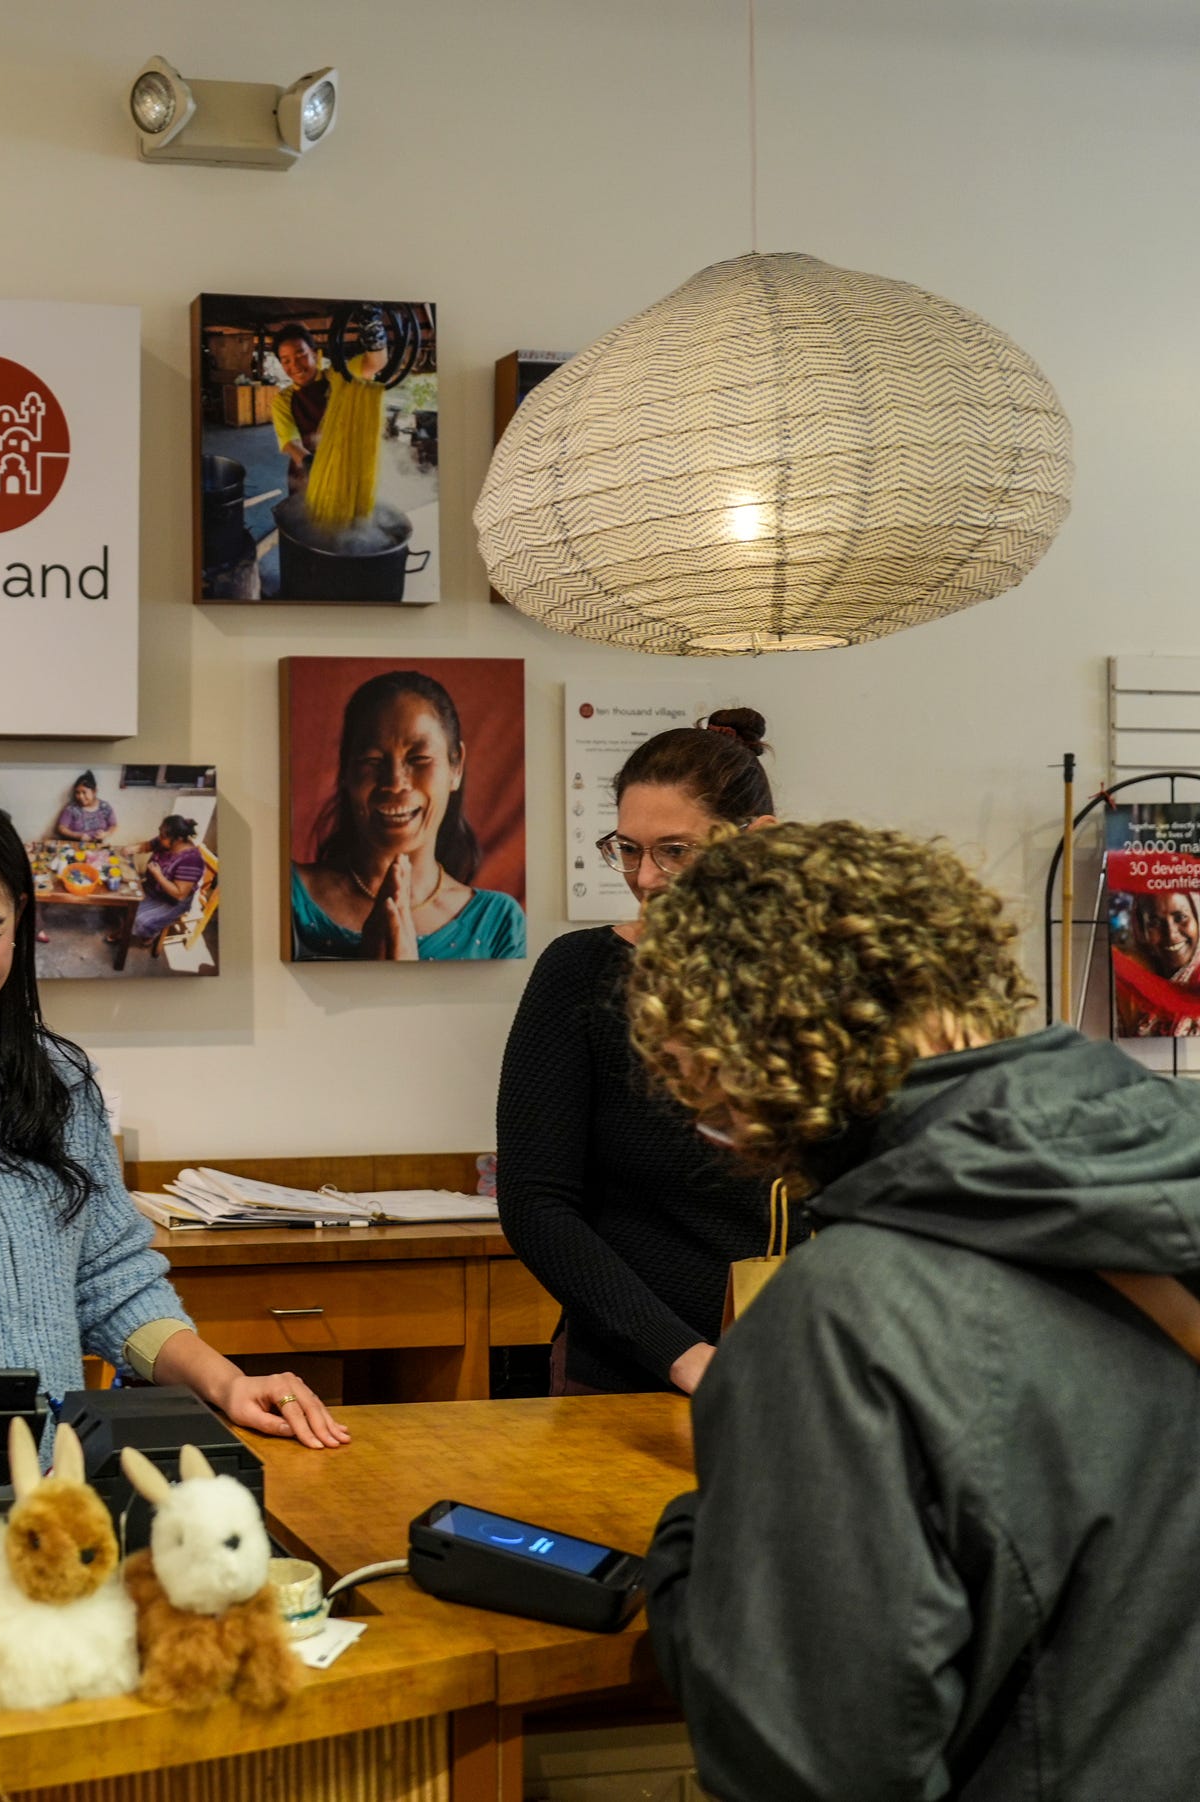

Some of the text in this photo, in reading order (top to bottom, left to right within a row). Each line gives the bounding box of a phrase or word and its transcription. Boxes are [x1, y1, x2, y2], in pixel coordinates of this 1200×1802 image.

[596, 707, 686, 719] ten thousand villages
[1124, 840, 1200, 855] 20,000 ma
[1129, 860, 1200, 877] 30 develop
[1146, 876, 1200, 890] countrie
